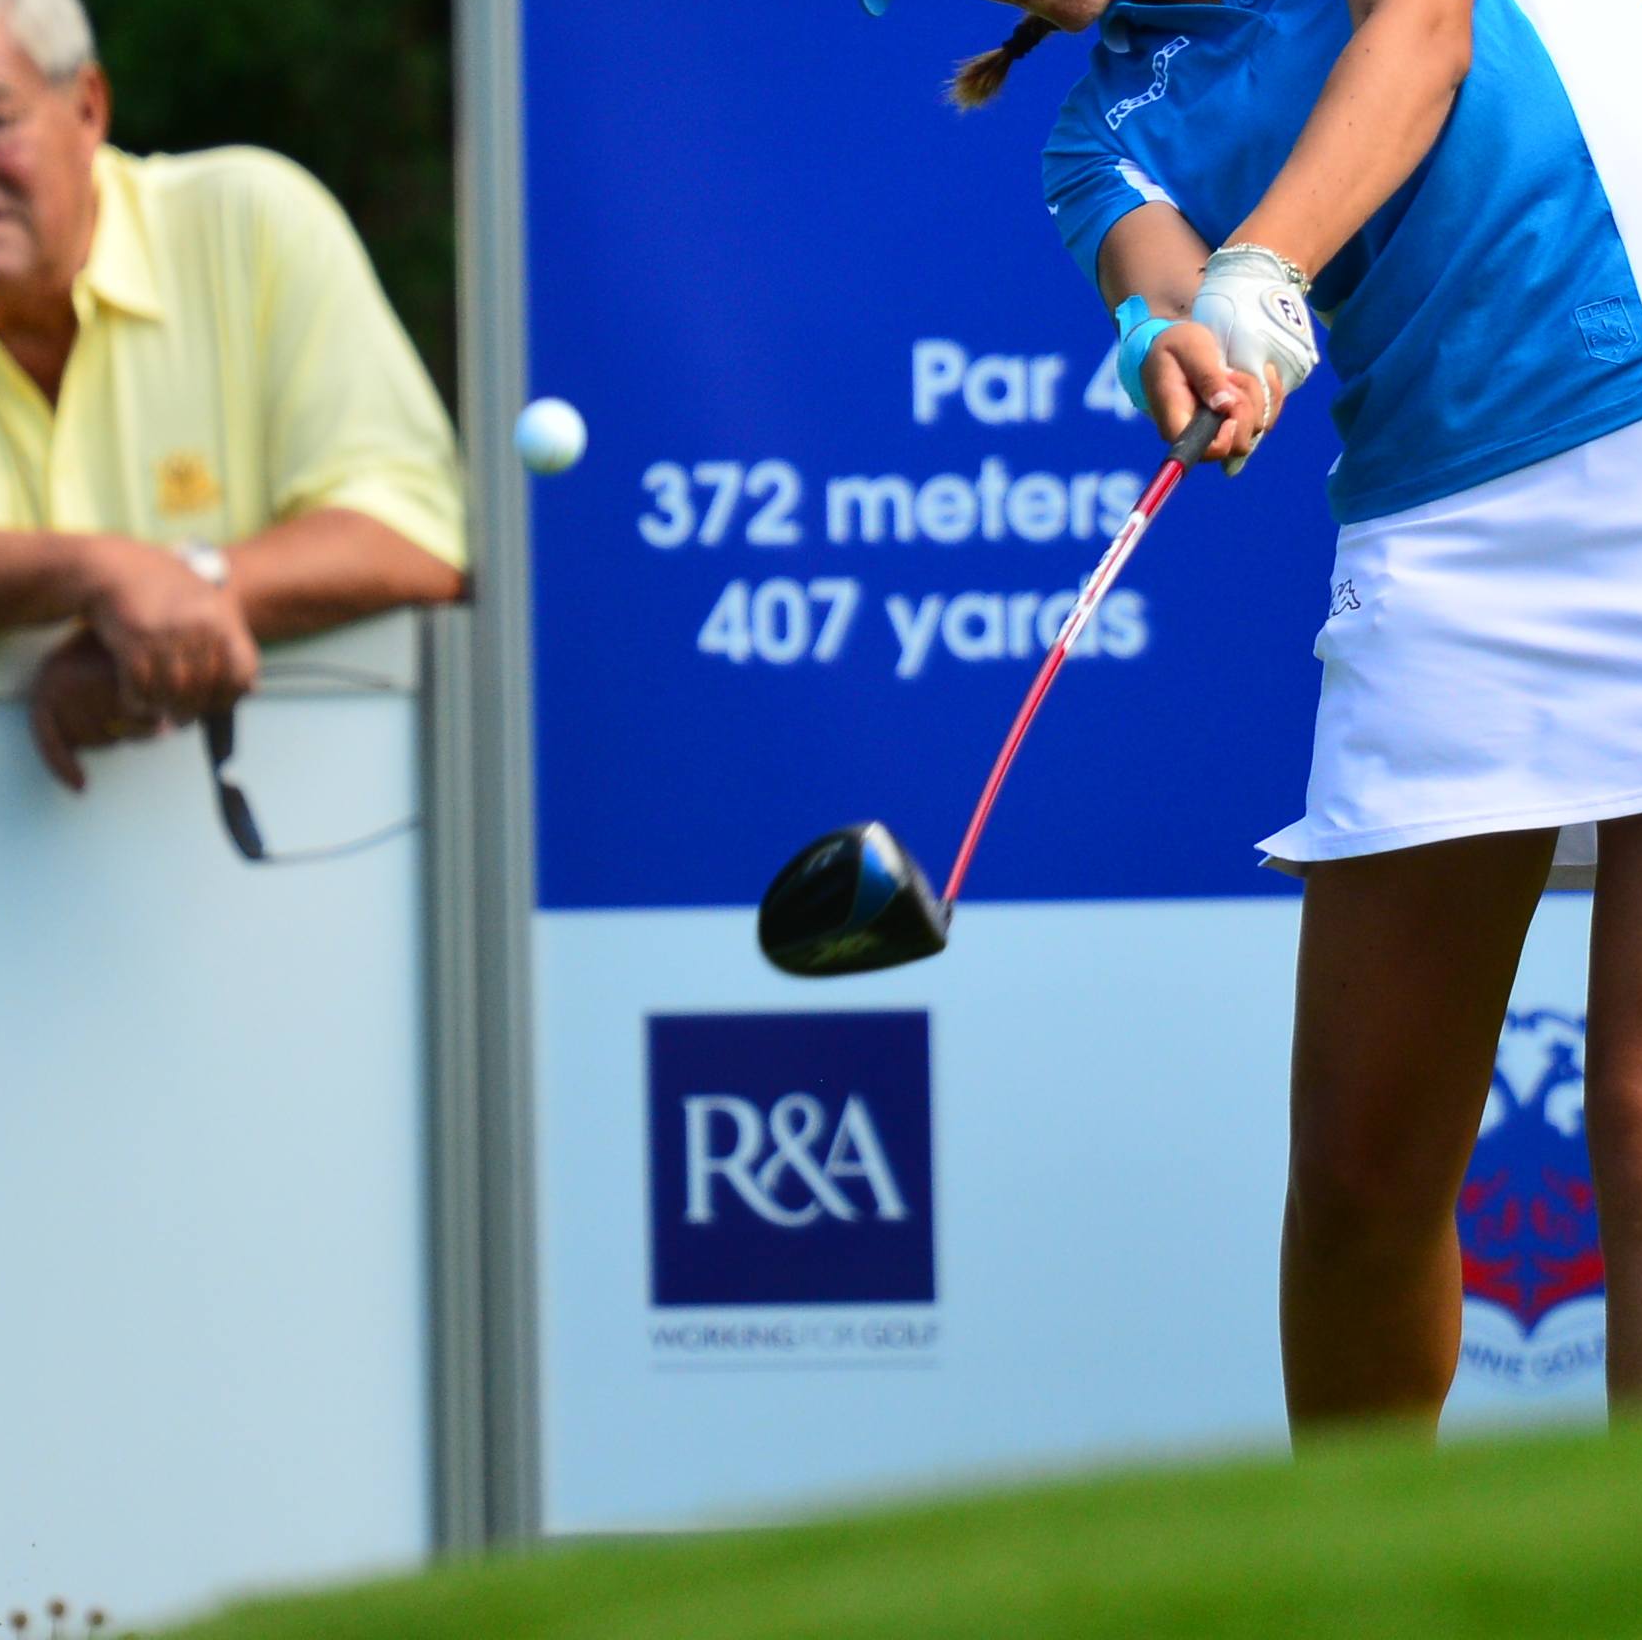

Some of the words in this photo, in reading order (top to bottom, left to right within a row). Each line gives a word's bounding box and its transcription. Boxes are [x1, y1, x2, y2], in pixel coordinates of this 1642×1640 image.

[913, 340, 1066, 423] Par
[637, 460, 803, 547] 372
[825, 456, 1145, 544] meters
[696, 579, 860, 665] 407
[682, 1093, 910, 1228] R&A
